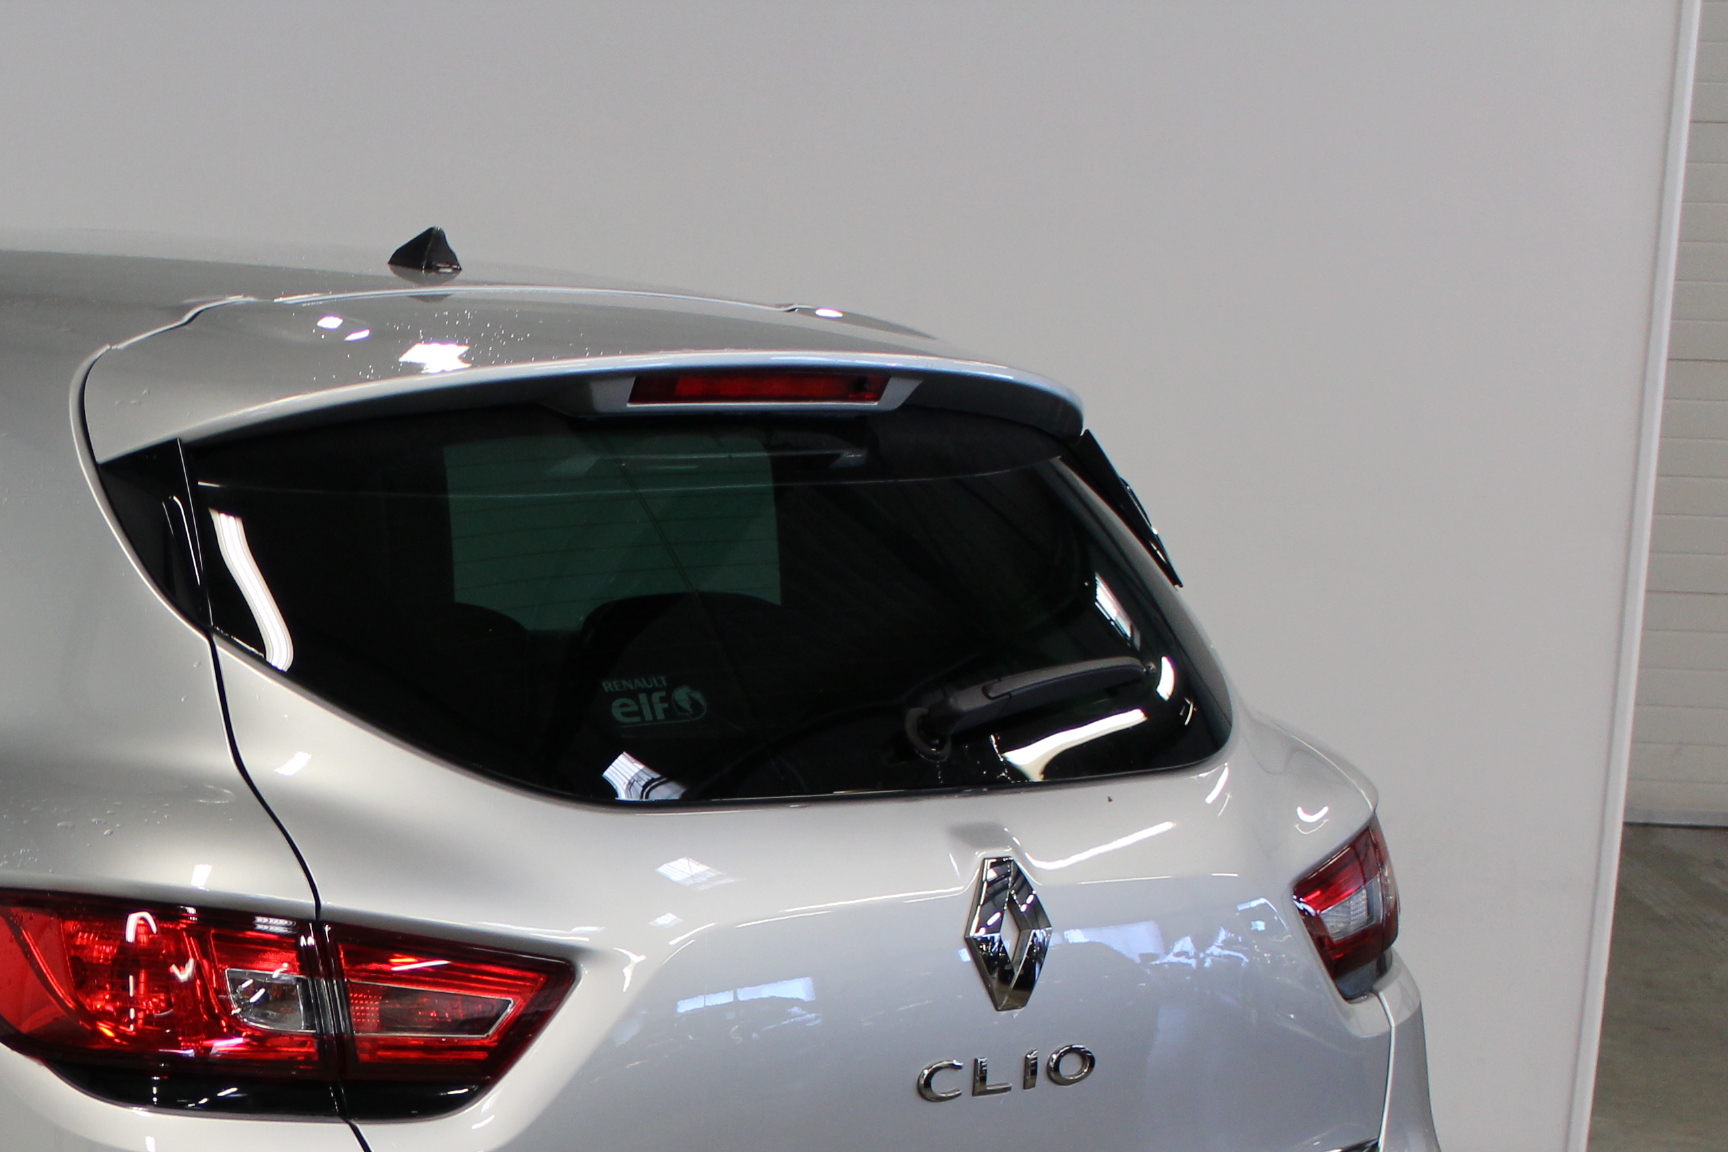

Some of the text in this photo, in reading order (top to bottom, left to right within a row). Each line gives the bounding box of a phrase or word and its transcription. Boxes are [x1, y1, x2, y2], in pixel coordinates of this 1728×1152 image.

[601, 676, 667, 692] RENAULT
[611, 691, 669, 723] elf
[917, 1044, 1096, 1102] CLIO
